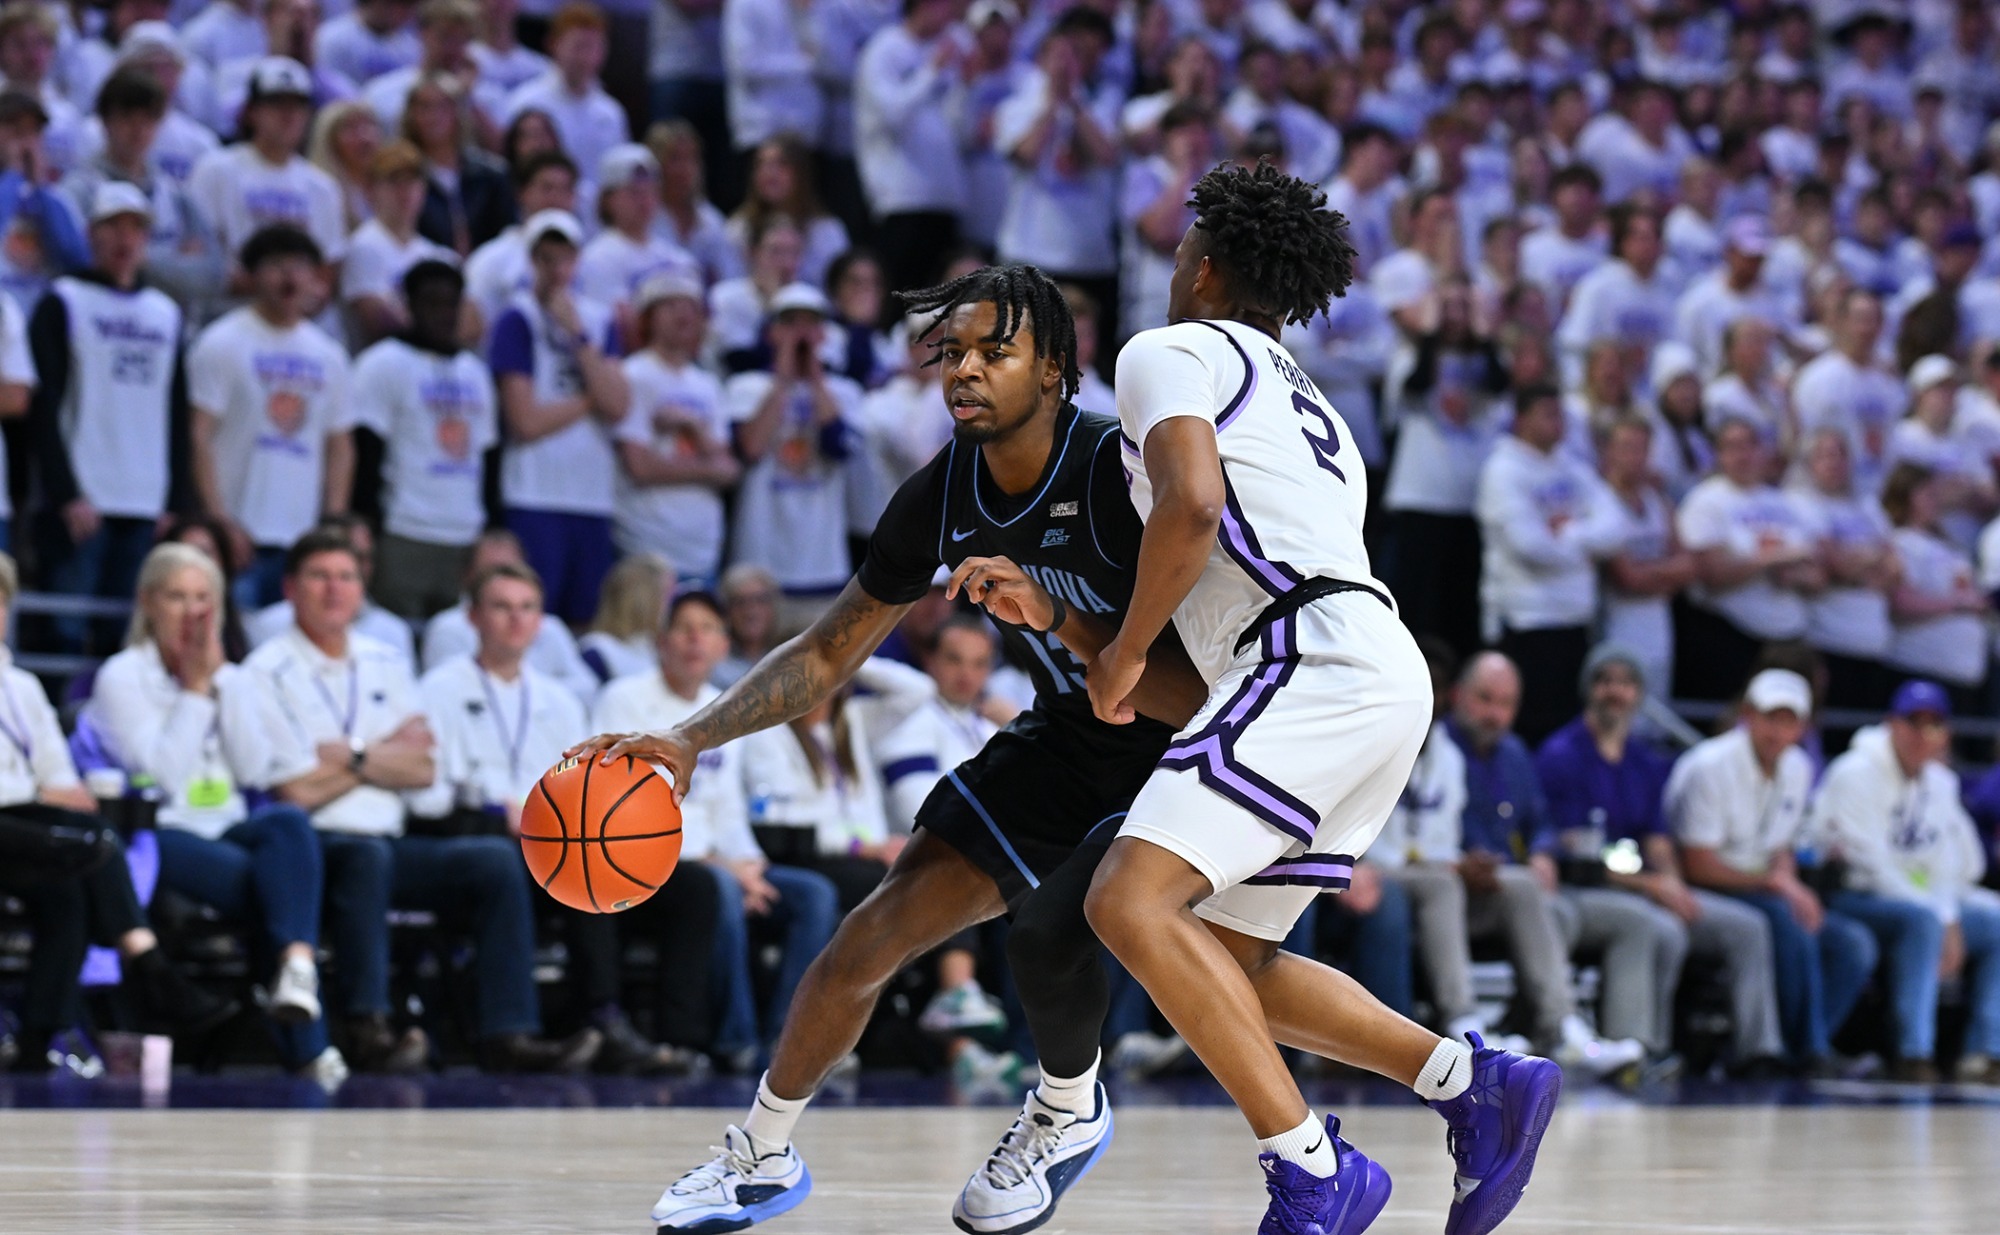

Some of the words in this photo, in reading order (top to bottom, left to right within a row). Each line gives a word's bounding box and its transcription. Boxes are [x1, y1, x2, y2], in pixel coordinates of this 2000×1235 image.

[1267, 347, 1318, 400] PERRY
[1291, 390, 1346, 485] 2
[1041, 535, 1071, 544] EAST
[1045, 528, 1065, 537] BIG
[1018, 630, 1088, 694] 13
